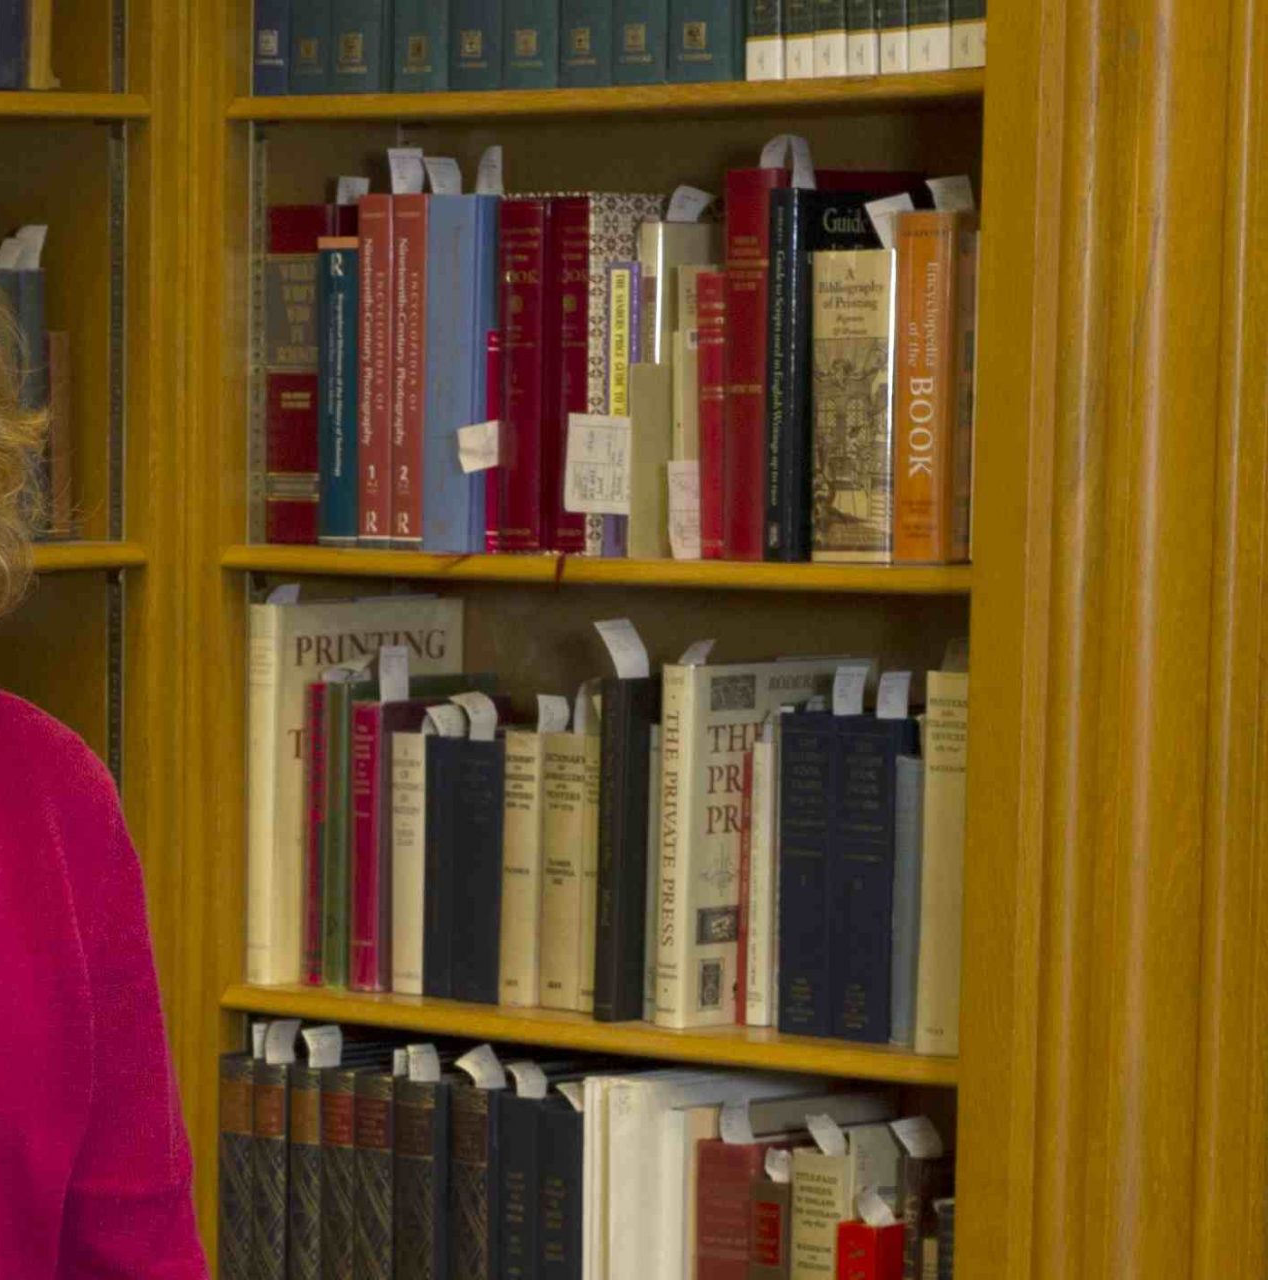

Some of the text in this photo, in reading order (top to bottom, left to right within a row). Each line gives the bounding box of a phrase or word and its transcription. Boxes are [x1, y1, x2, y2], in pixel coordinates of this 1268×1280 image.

[776, 250, 785, 281] Guide
[818, 280, 884, 295] Bibliography
[773, 296, 784, 332] Scripts
[925, 261, 940, 367] Encyclopedia
[361, 238, 374, 447] Nineteenth-Century Photography
[394, 238, 409, 447] Nineteenth-Century Photography
[907, 321, 920, 366] of the
[772, 371, 782, 410] English
[771, 411, 782, 454] Writings
[908, 376, 935, 478] BOOK
[661, 710, 680, 948] THE PRIVATE PRESS
[847, 1247, 865, 1260] A
